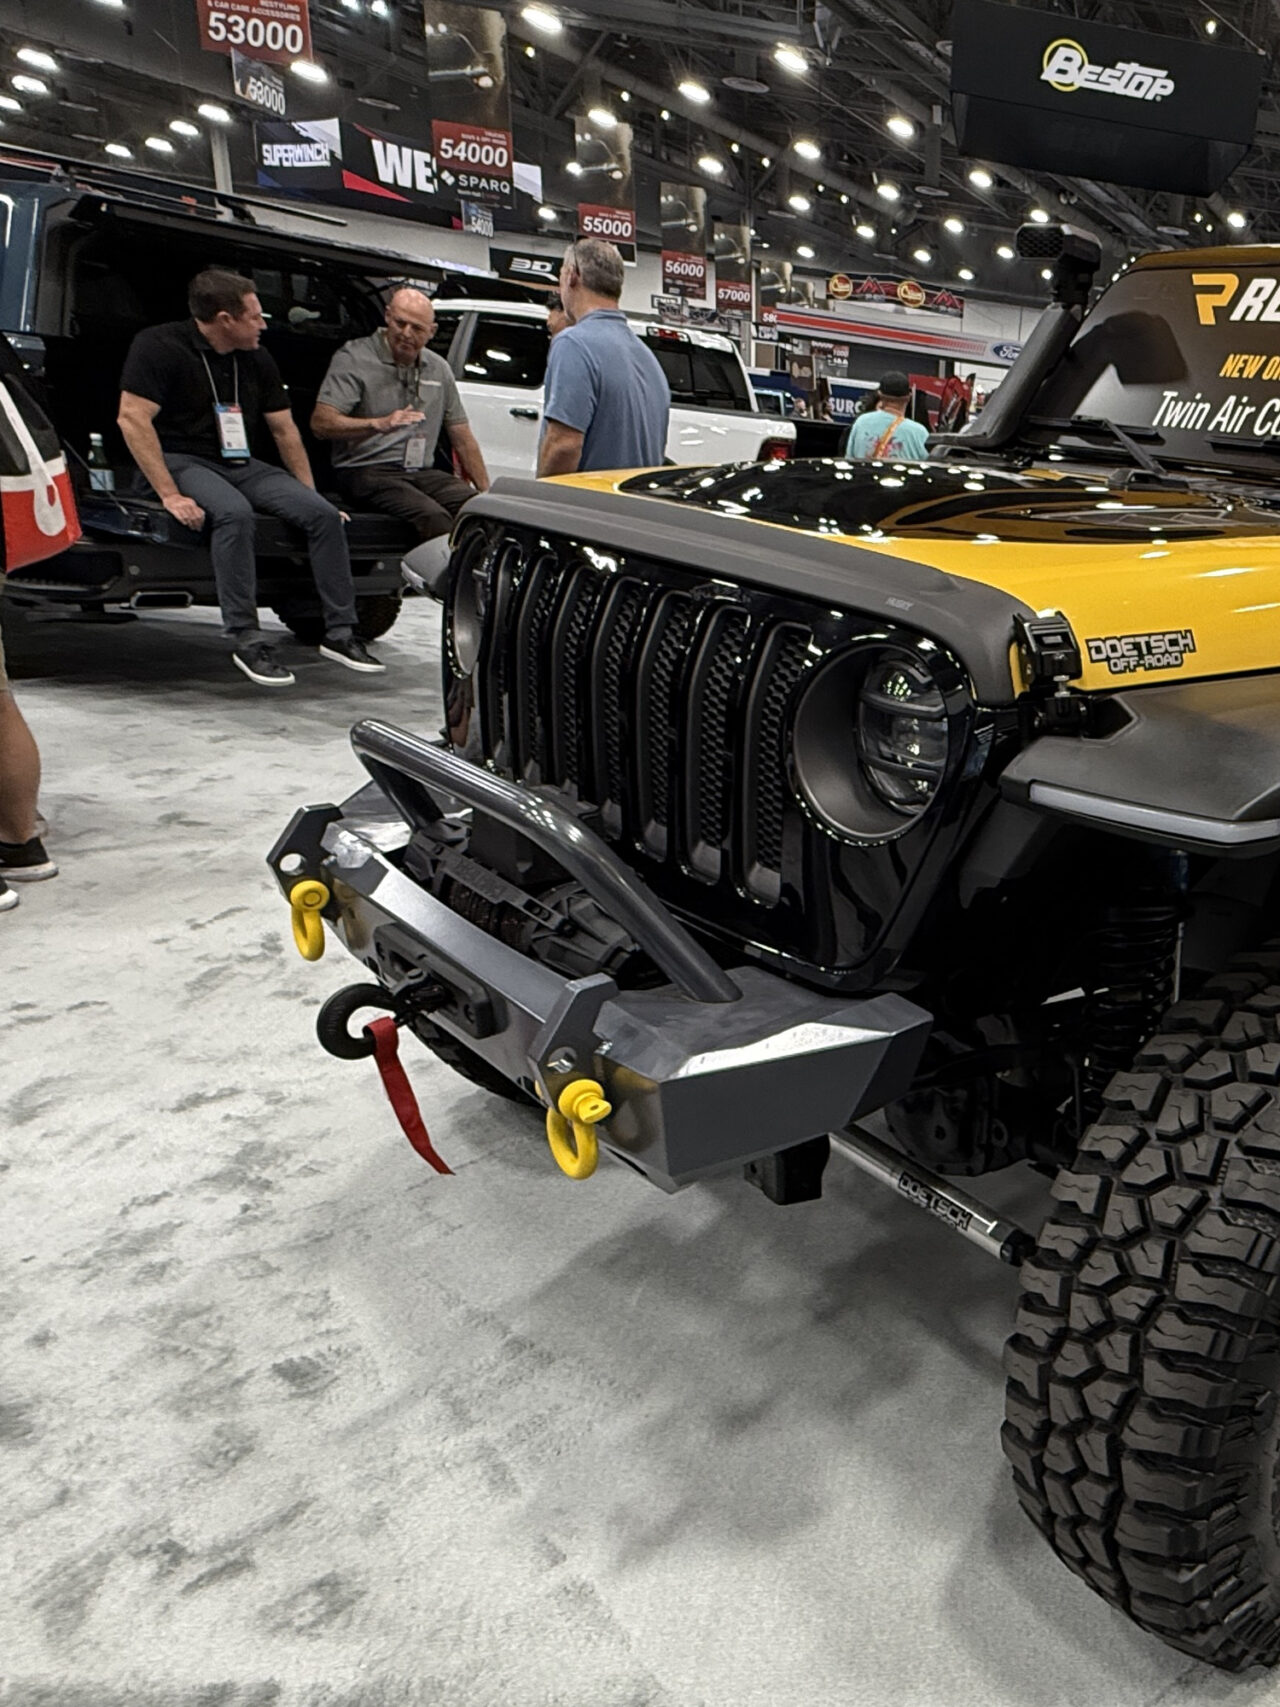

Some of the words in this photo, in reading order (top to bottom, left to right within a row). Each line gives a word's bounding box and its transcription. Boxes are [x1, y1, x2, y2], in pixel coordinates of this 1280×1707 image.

[208, 11, 303, 53] 53000
[248, 75, 285, 115] 53000
[262, 143, 331, 167] SUPERWINCH
[440, 138, 508, 168] 54000
[458, 174, 511, 194] SPARQ
[583, 216, 632, 237] 55000
[665, 261, 704, 278] 56000
[717, 288, 751, 302] 57000
[1219, 353, 1263, 378] NEW
[1152, 390, 1212, 431] Twin
[1208, 395, 1256, 436] Air
[1088, 632, 1195, 661] DOETSCH
[1110, 653, 1182, 672] OFF-ROAD
[900, 1173, 973, 1231] DOETSCH
